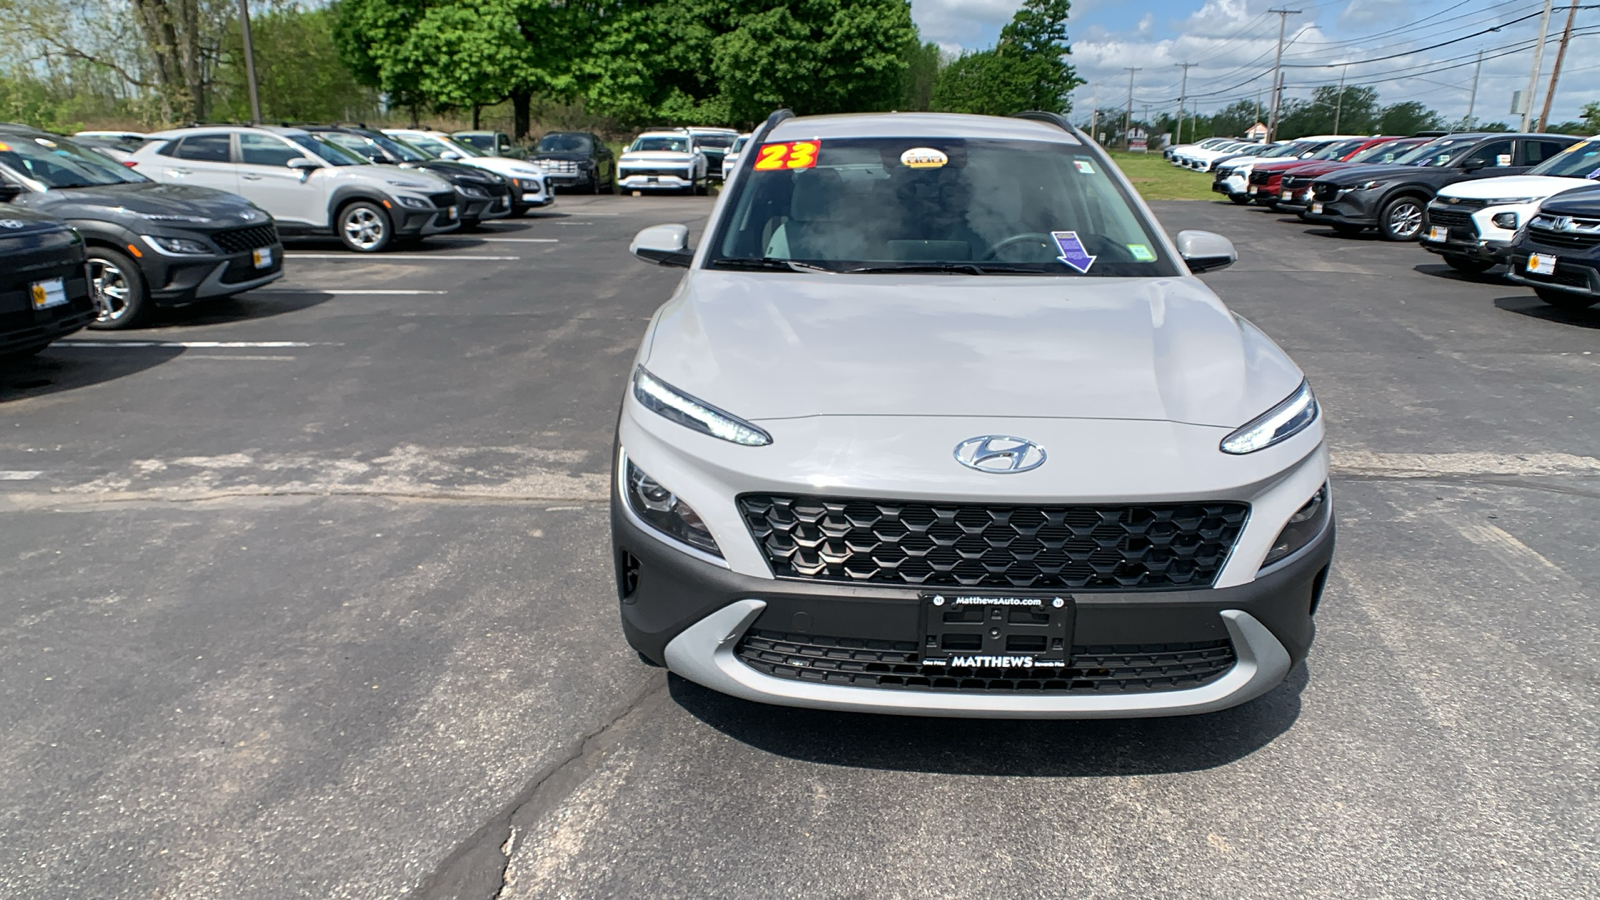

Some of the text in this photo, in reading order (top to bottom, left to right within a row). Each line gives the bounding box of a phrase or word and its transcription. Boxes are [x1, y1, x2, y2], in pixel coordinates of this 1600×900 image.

[756, 143, 817, 169] 23
[956, 596, 1042, 606] MatthewsAuto.com
[952, 656, 1033, 668] MATTHEWS
